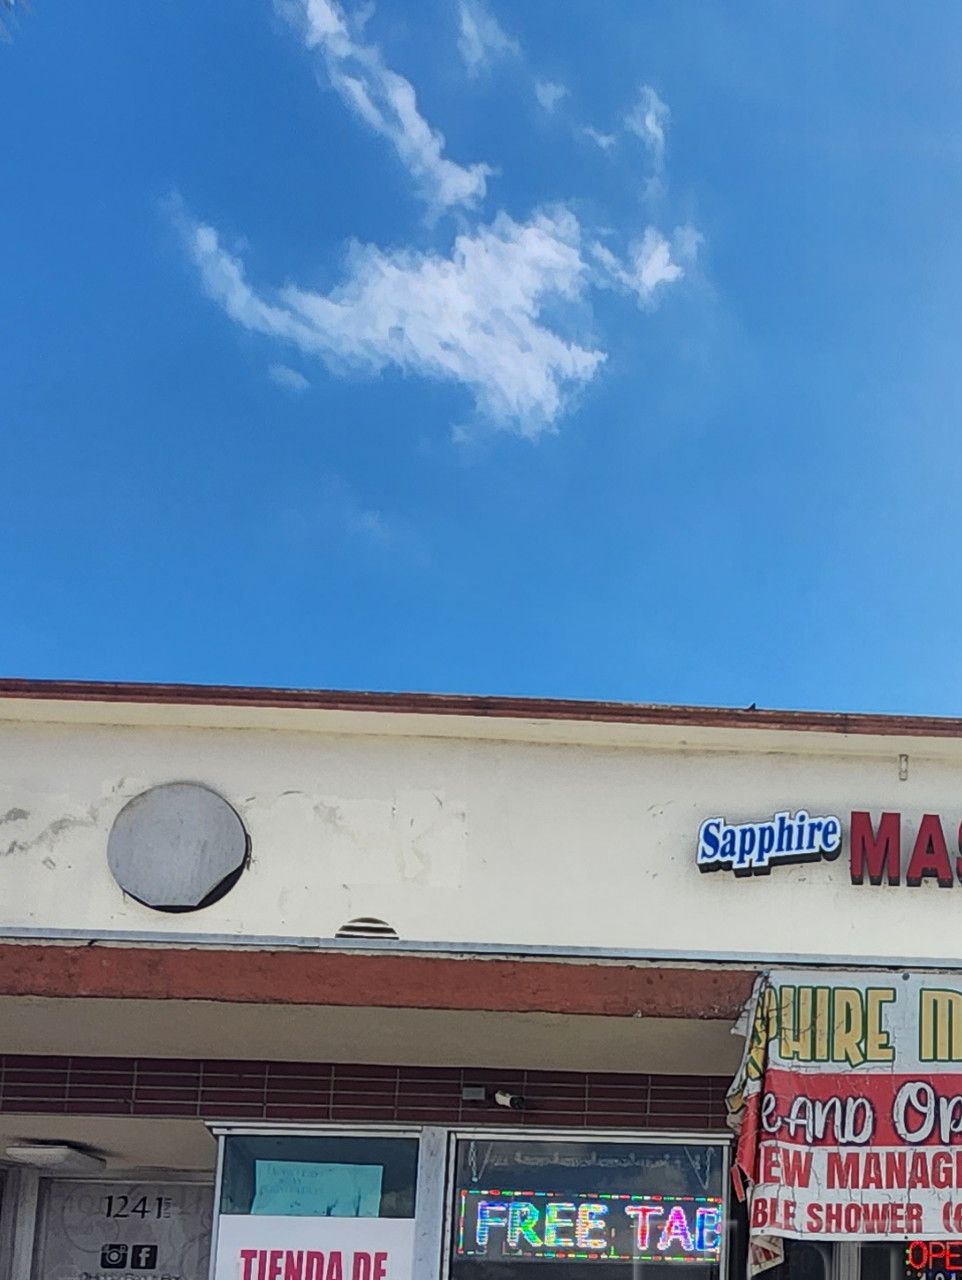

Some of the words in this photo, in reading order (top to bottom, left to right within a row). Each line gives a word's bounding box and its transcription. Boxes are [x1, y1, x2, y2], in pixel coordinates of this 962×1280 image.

[698, 811, 842, 870] Sapphire
[105, 1195, 163, 1219] 1241
[476, 1201, 608, 1248] FREE
[806, 1202, 923, 1234] SHOWER
